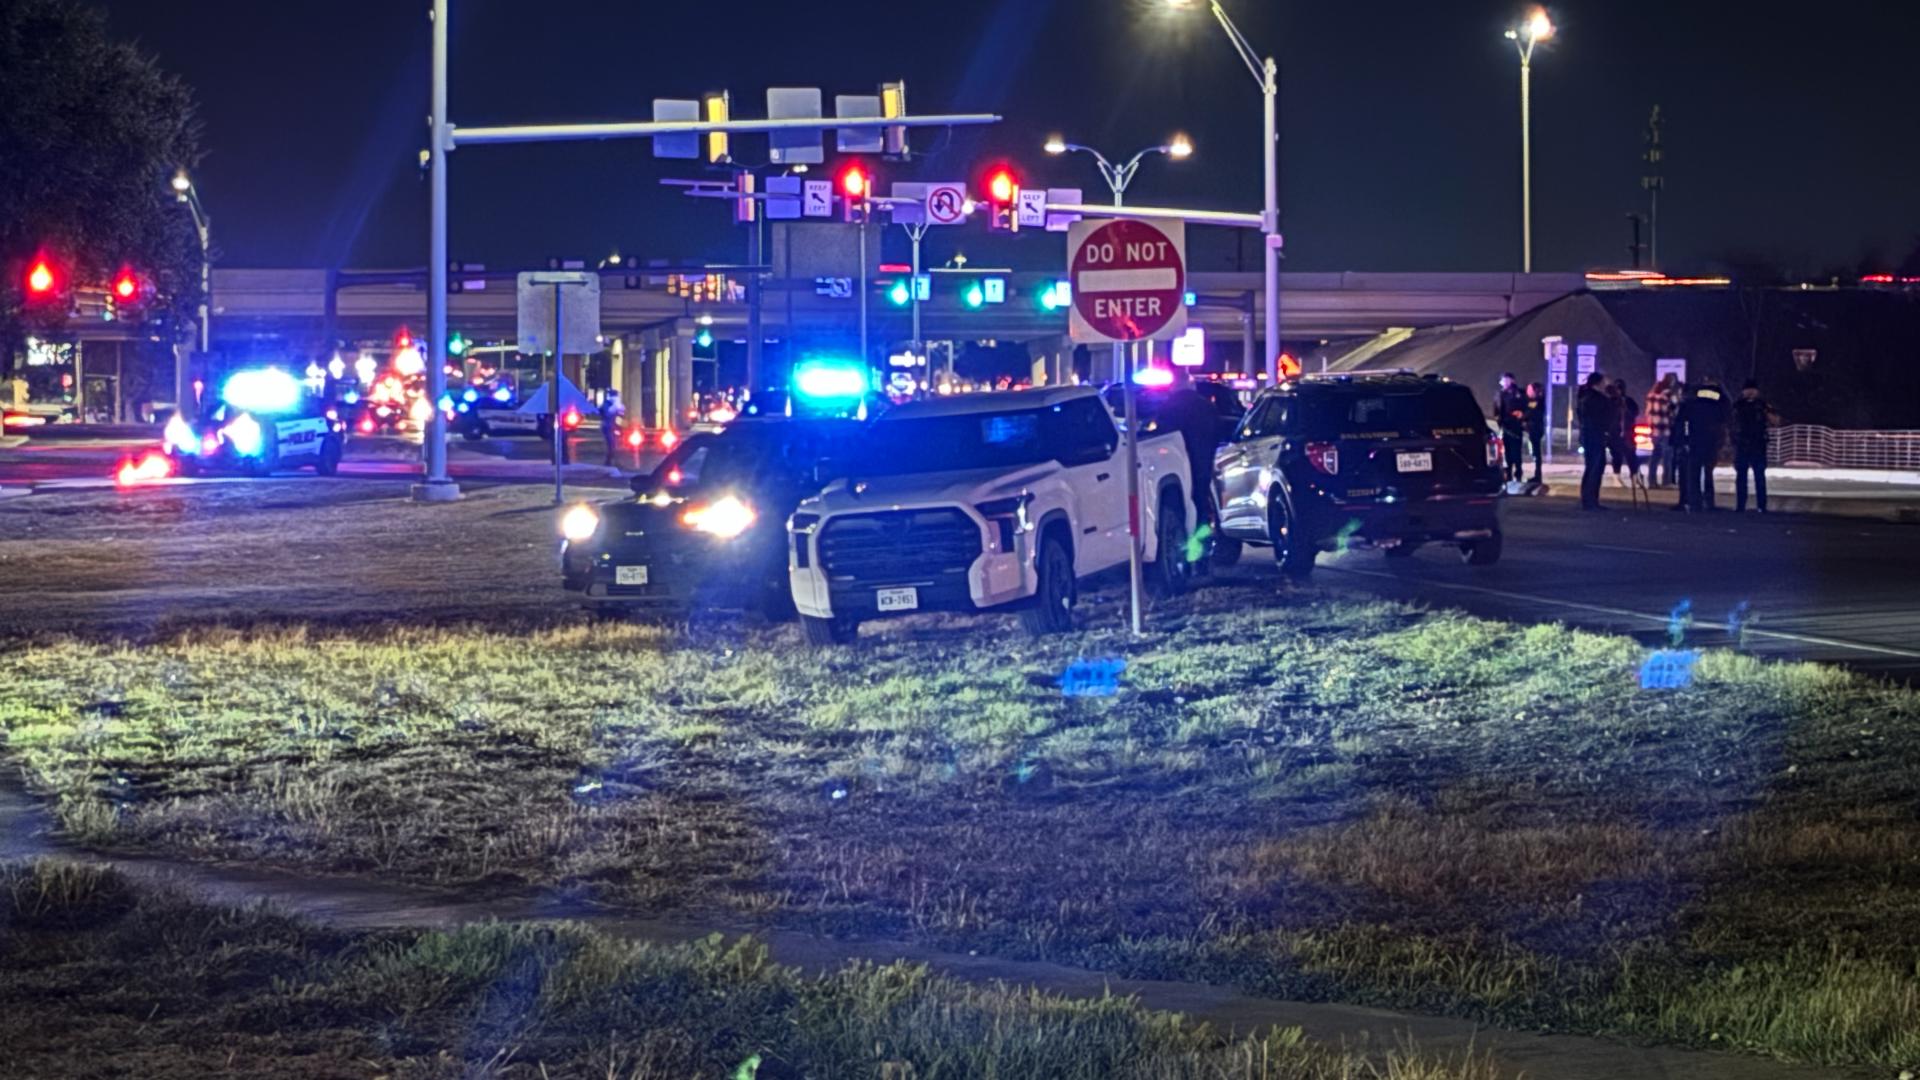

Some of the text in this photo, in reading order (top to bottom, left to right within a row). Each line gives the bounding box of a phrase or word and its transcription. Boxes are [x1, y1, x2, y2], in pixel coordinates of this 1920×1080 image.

[1086, 242, 1167, 263] DO NOT
[1095, 297, 1161, 318] ENTER
